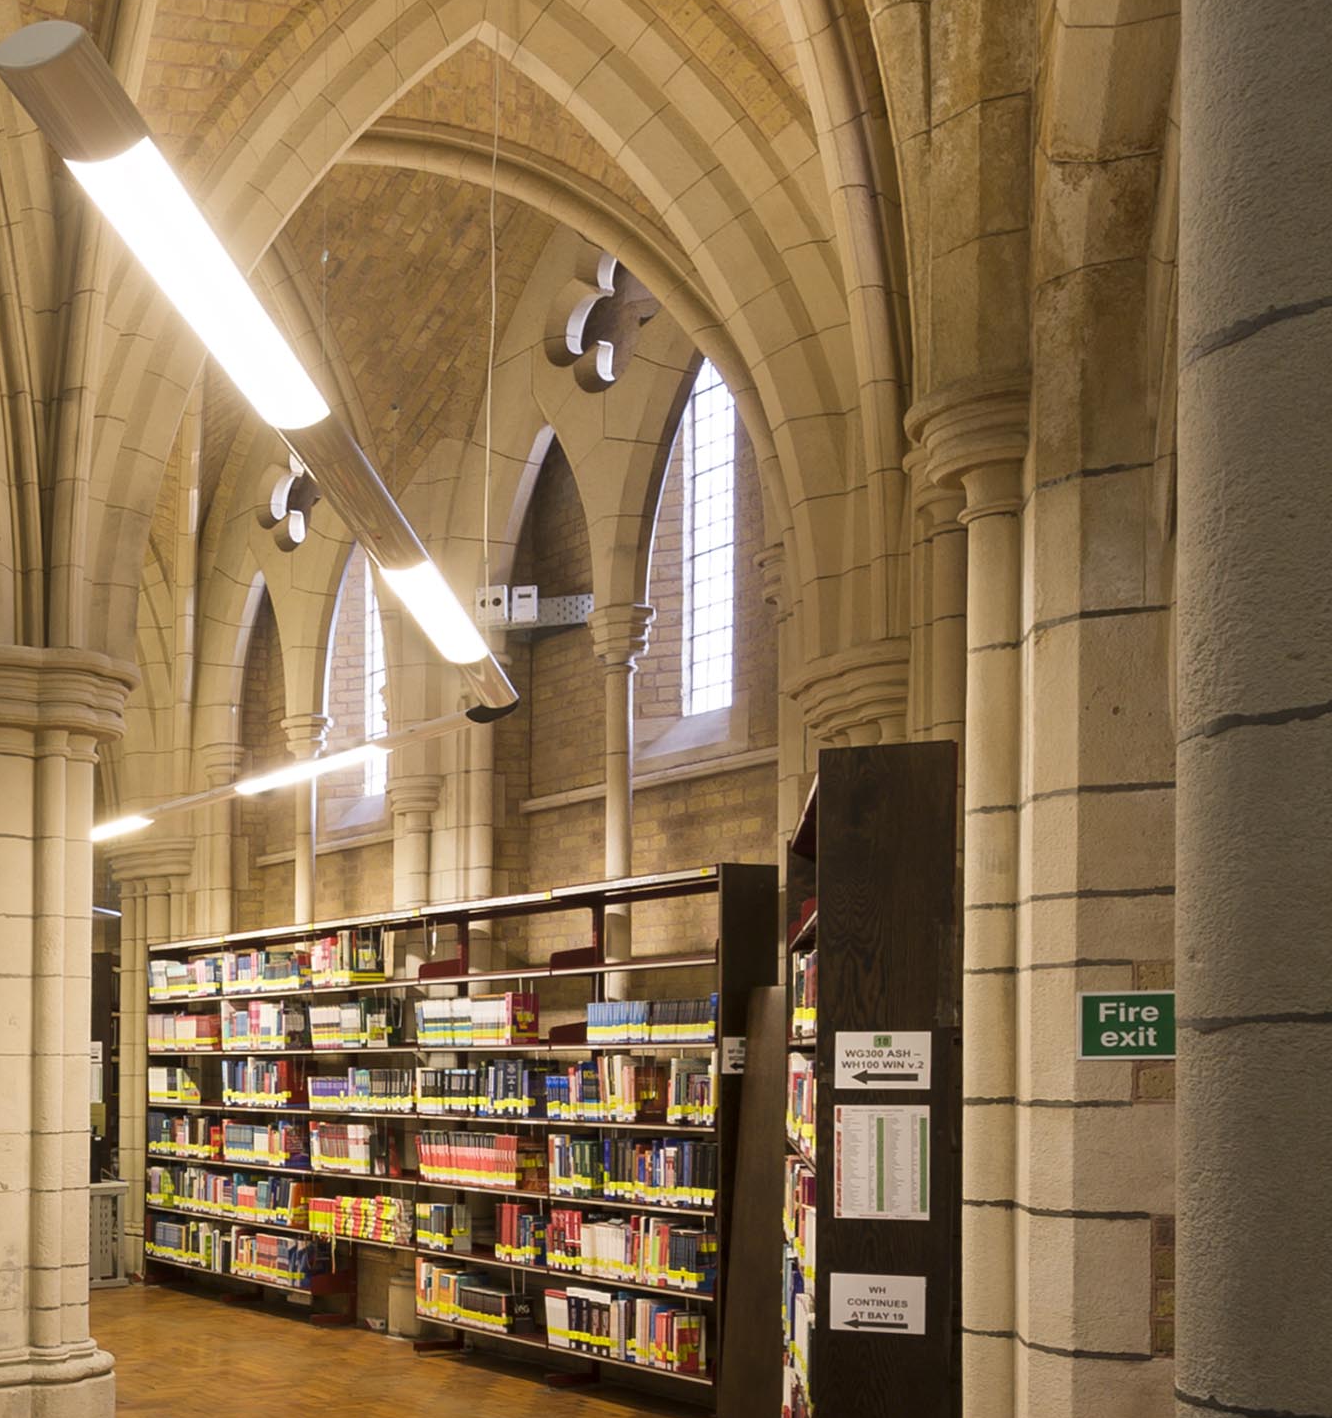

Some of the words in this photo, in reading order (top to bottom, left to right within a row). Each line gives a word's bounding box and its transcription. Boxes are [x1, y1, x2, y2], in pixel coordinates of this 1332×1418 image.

[1099, 1002, 1159, 1022] Fire
[1100, 1026, 1157, 1047] exit
[844, 1049, 884, 1058] WG300
[886, 1049, 911, 1058] ASH
[841, 1061, 879, 1069] WH100
[882, 1061, 905, 1069] WIN
[907, 1061, 924, 1069] v.2
[868, 1286, 887, 1294] WH
[847, 1298, 909, 1308] CONTINUES
[851, 1311, 865, 1319] AT
[867, 1311, 890, 1320] BAY
[892, 1313, 904, 1321] 19
